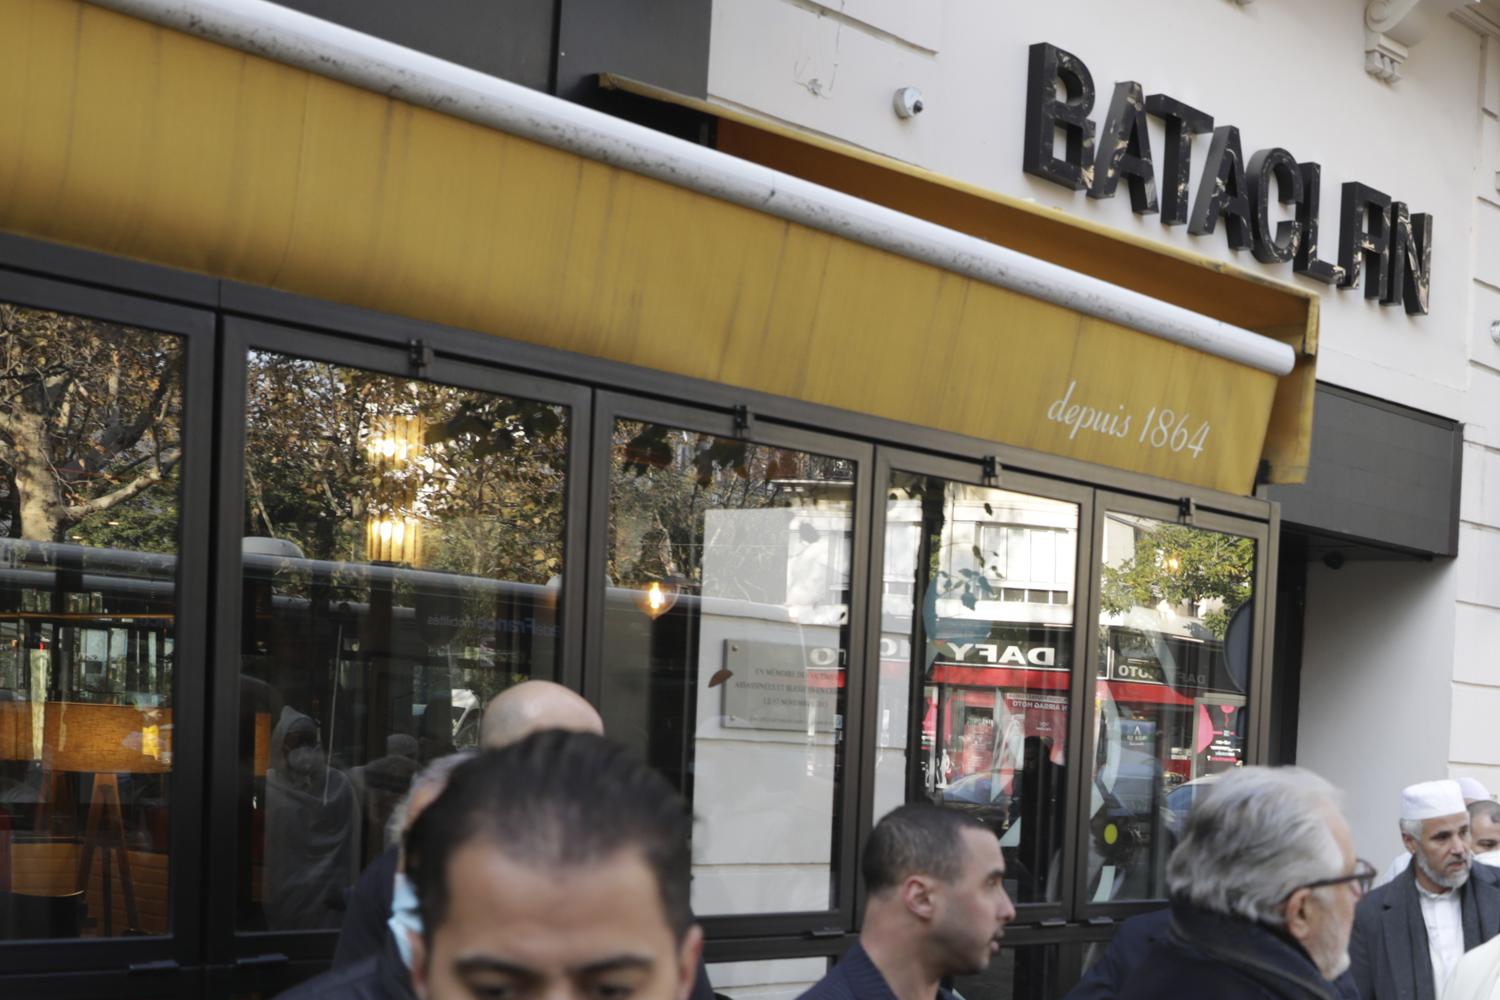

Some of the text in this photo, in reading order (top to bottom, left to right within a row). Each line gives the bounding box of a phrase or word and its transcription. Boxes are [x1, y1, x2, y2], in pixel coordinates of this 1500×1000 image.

[1023, 42, 1433, 316] BATACLAN
[1047, 380, 1211, 459] depuis 1864
